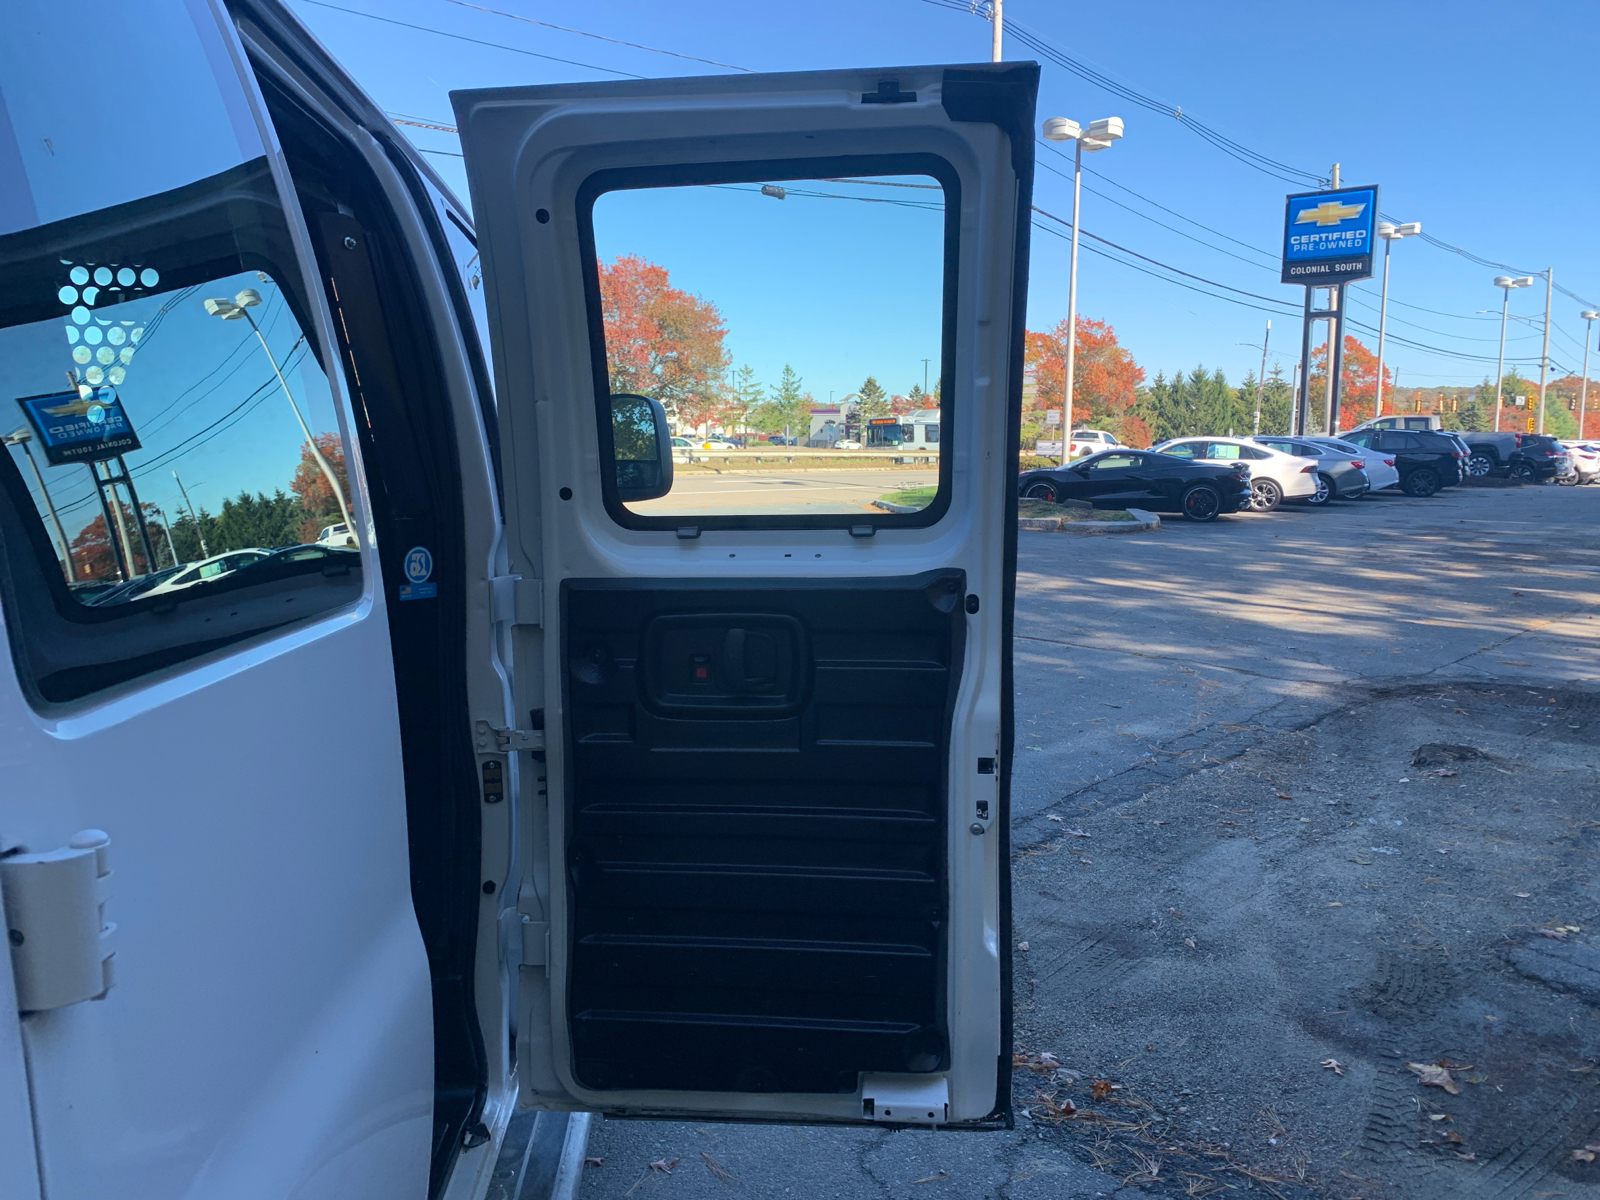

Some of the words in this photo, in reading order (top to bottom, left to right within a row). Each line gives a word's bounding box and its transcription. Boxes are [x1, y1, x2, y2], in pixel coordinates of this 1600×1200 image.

[1290, 229, 1367, 244] CERTIFIED
[1293, 239, 1362, 252] PRE-OWNED
[1290, 264, 1331, 275] COLONIAL
[1334, 262, 1363, 272] SOUTH
